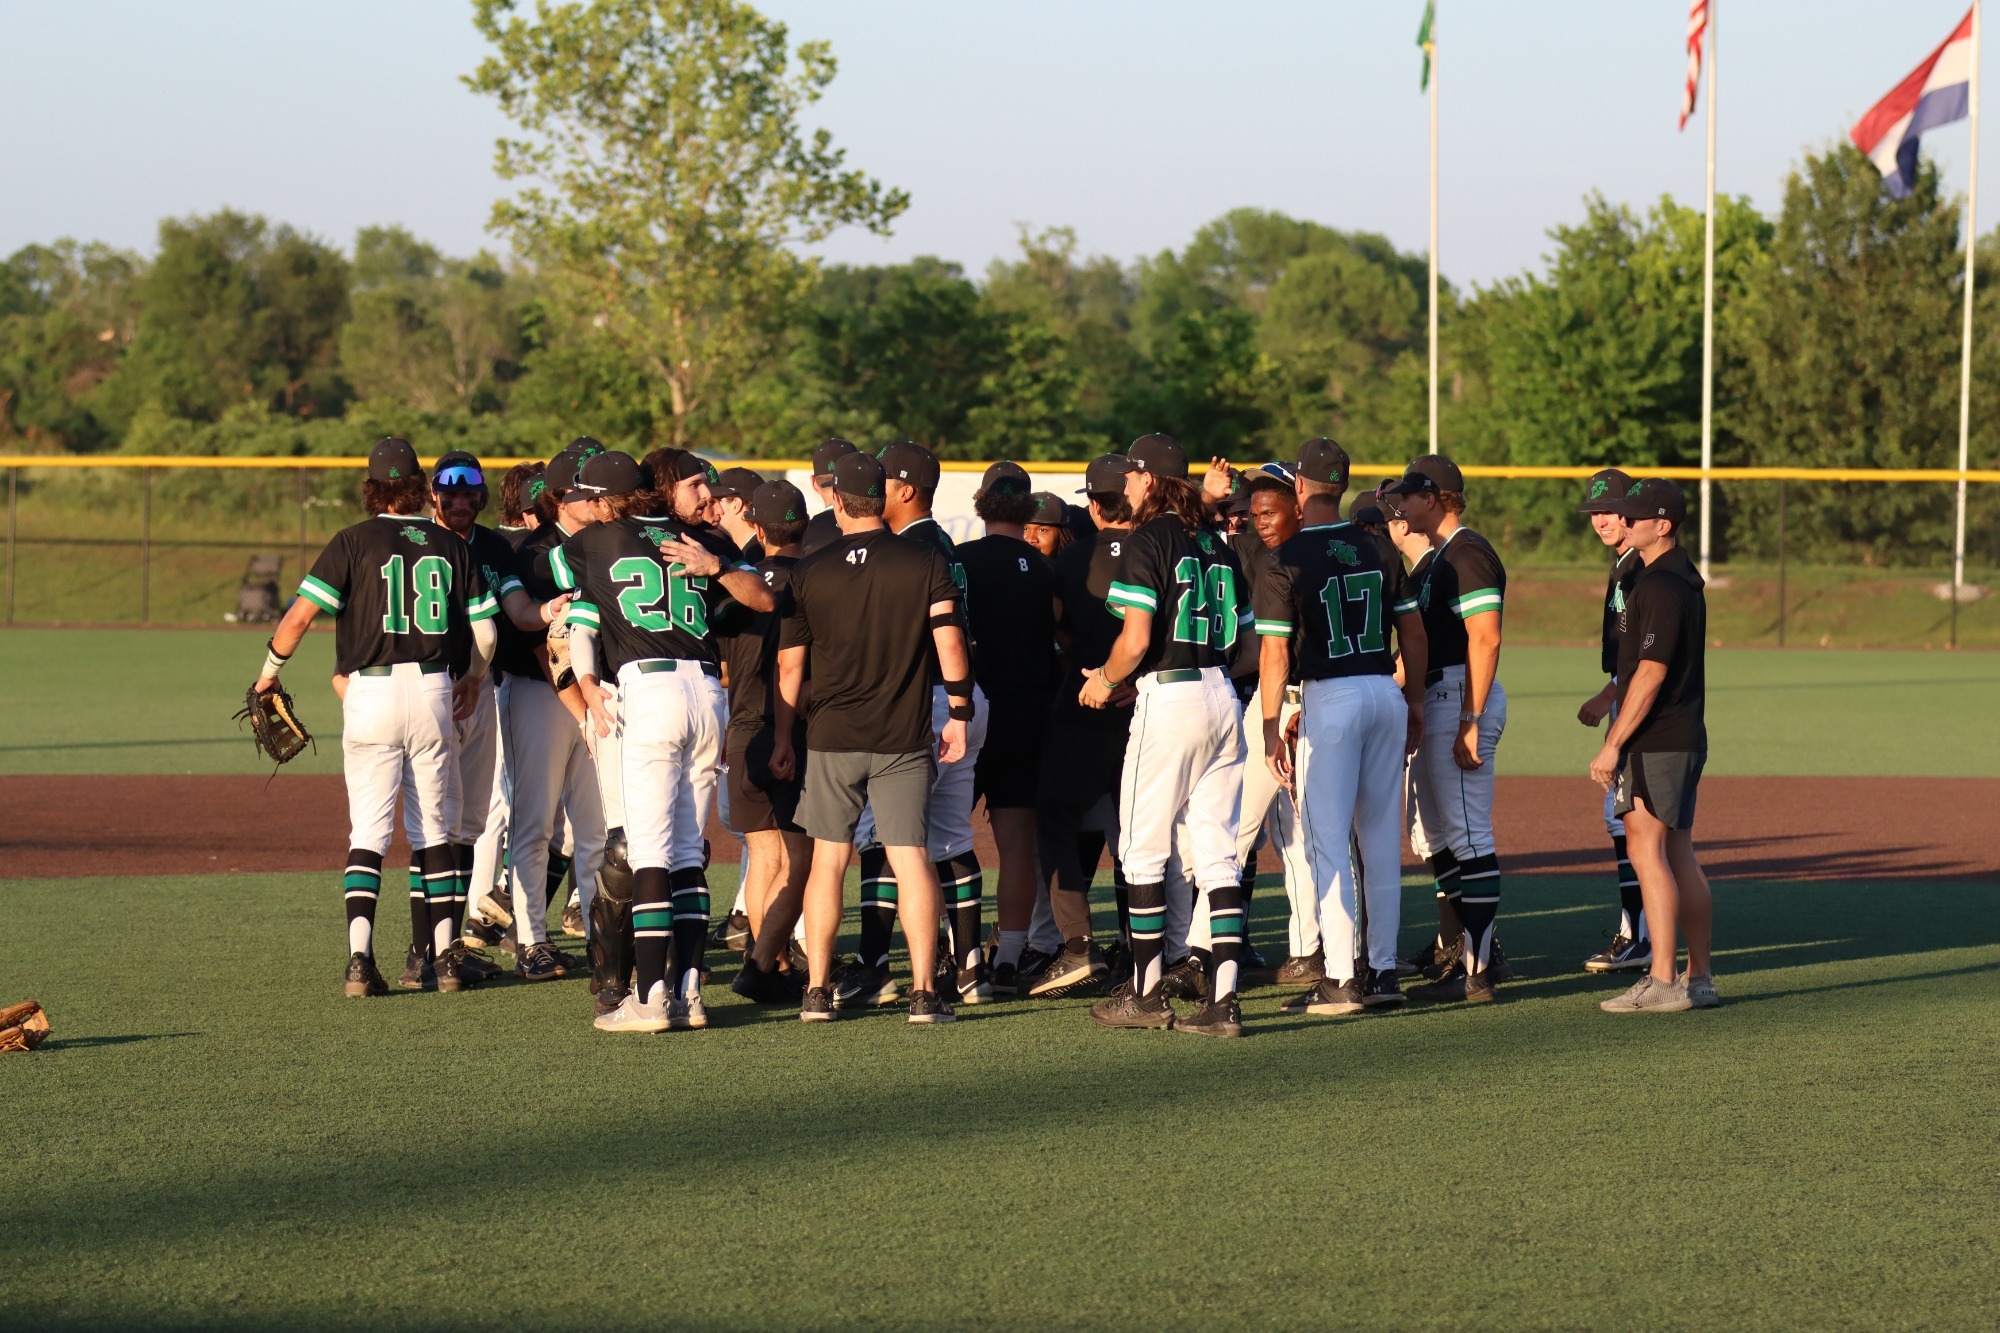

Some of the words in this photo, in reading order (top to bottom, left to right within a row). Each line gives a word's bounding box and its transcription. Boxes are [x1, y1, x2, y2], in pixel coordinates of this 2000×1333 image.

[846, 548, 867, 564] 47
[1018, 558, 1028, 571] 8
[1111, 542, 1120, 556] 3
[381, 554, 452, 634] 18
[609, 557, 709, 640] 26
[764, 571, 774, 587] 2
[1173, 557, 1238, 650] 28
[1320, 570, 1384, 658] 17
